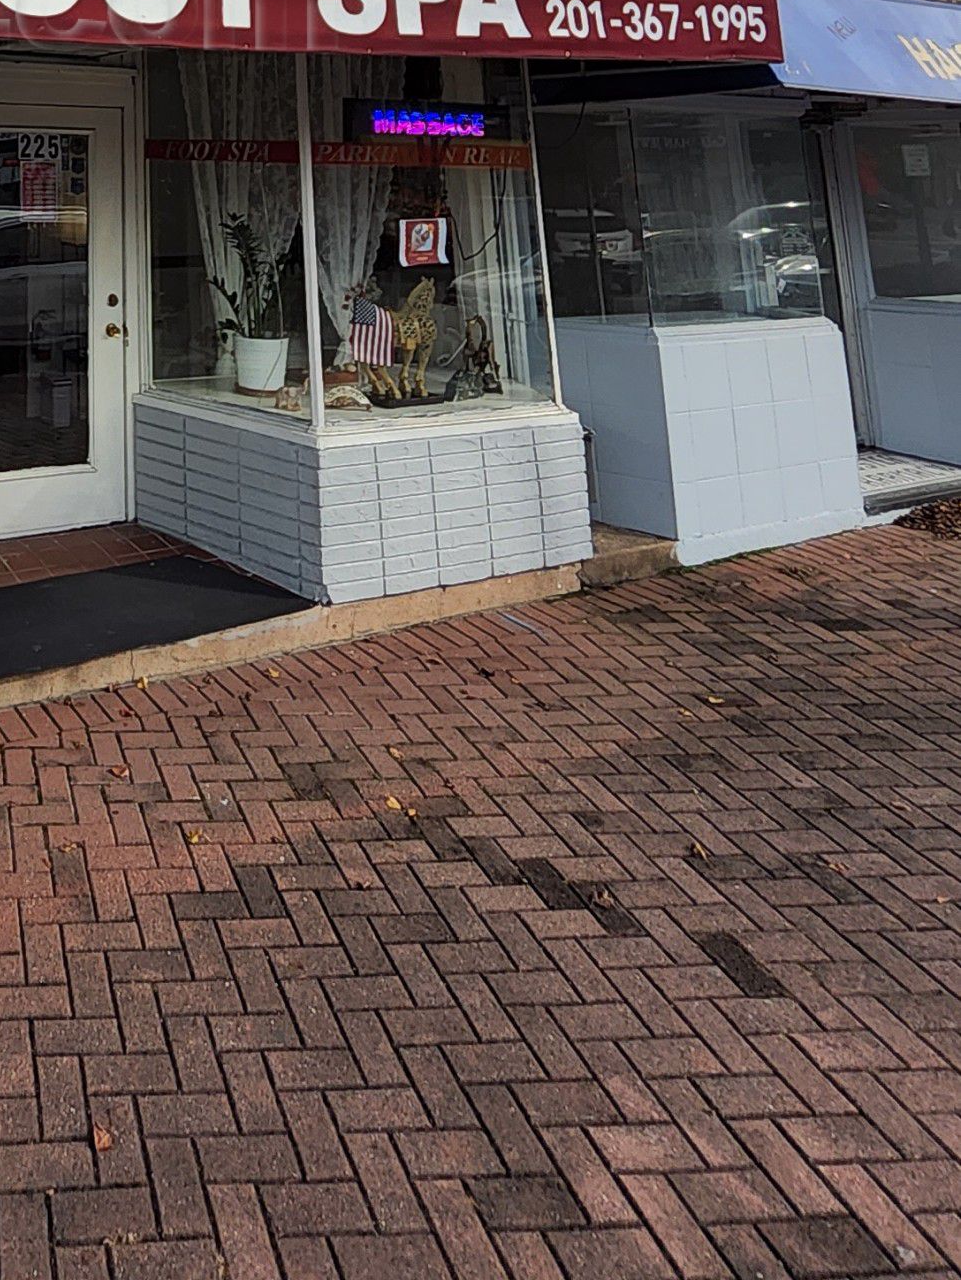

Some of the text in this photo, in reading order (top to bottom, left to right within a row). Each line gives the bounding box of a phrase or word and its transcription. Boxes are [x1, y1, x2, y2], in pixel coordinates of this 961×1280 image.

[373, 109, 485, 136] MASSAGE
[19, 133, 60, 159] 225
[165, 140, 270, 162] FOOT SPA
